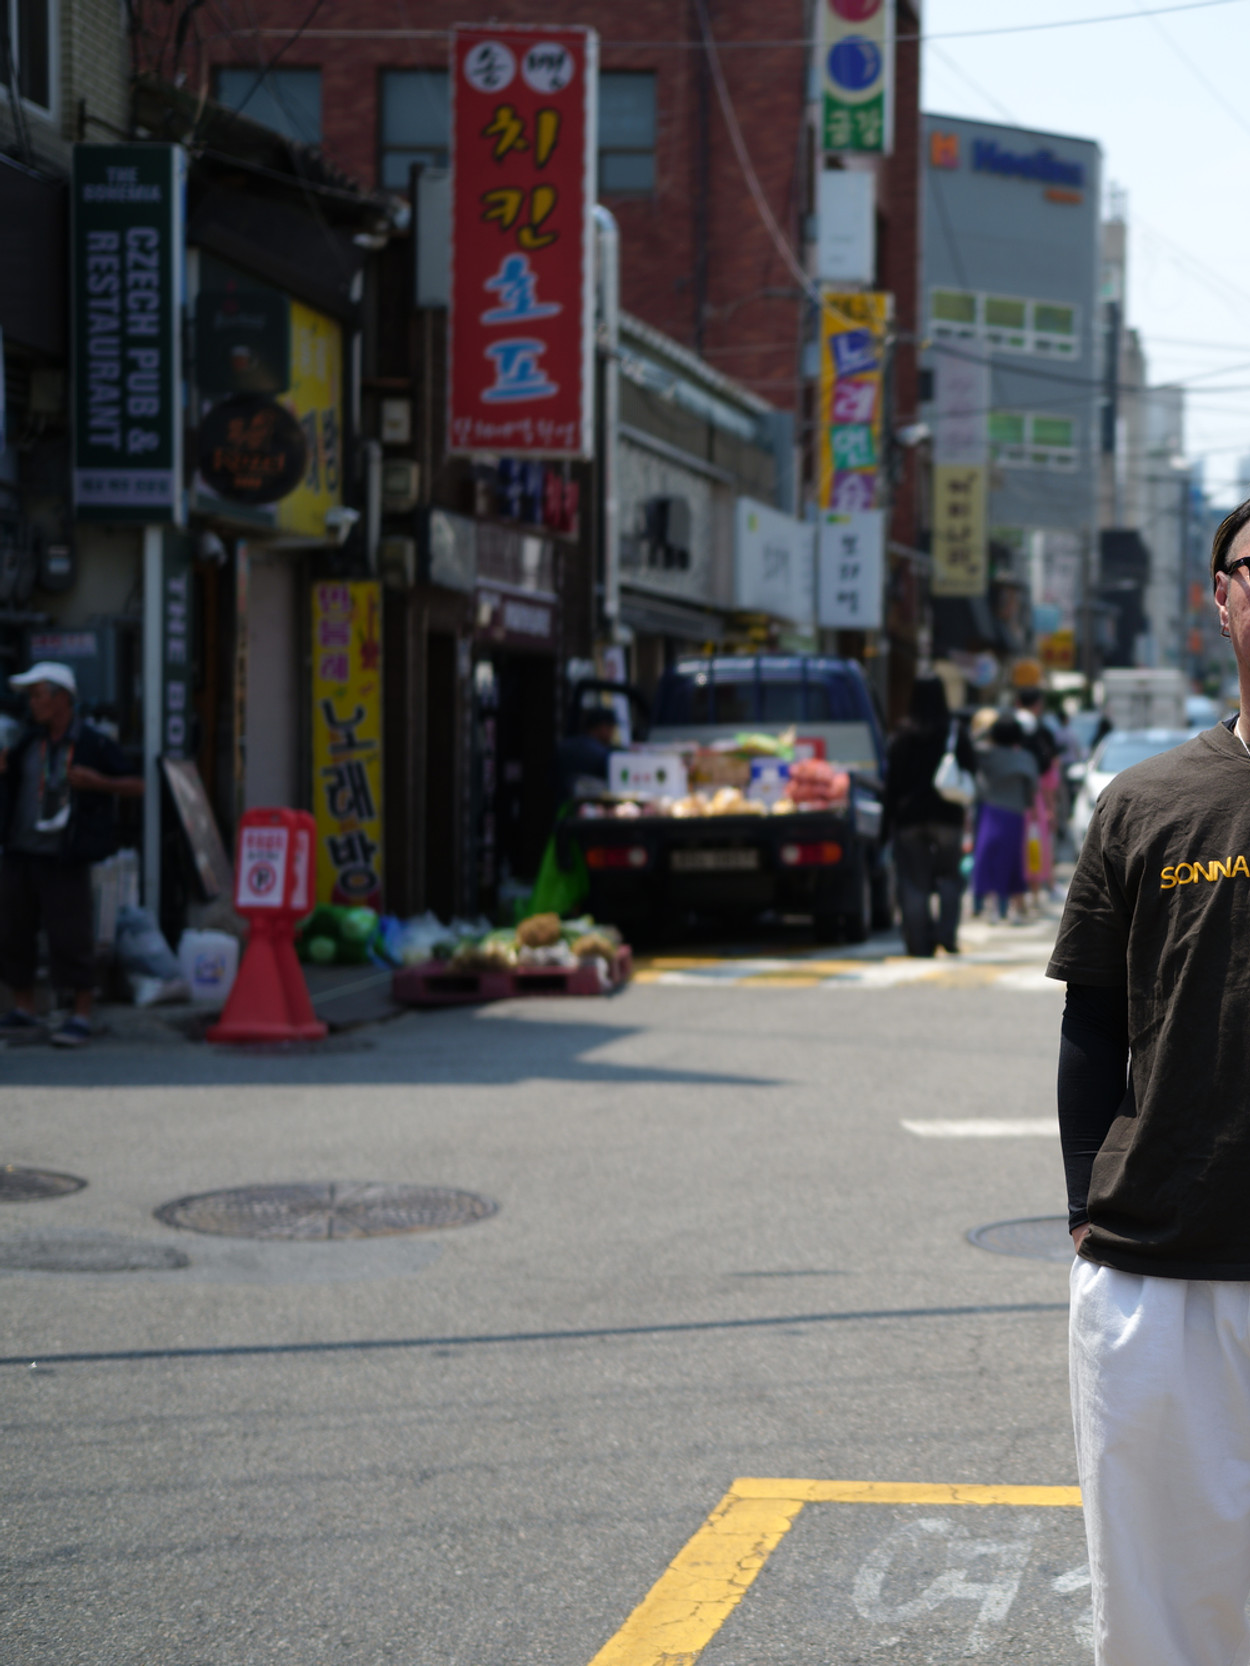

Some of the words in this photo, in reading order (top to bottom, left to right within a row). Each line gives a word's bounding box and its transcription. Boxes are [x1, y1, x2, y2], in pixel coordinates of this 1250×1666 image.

[107, 166, 138, 182] THE
[481, 105, 563, 251] 치킨
[127, 226, 159, 337] CZECH
[480, 253, 563, 403] 호프
[87, 230, 121, 450] RESTAURANT
[127, 346, 159, 418] PUB
[127, 427, 160, 453] &
[322, 699, 379, 893] 노래방
[1160, 856, 1250, 888] SONNA
